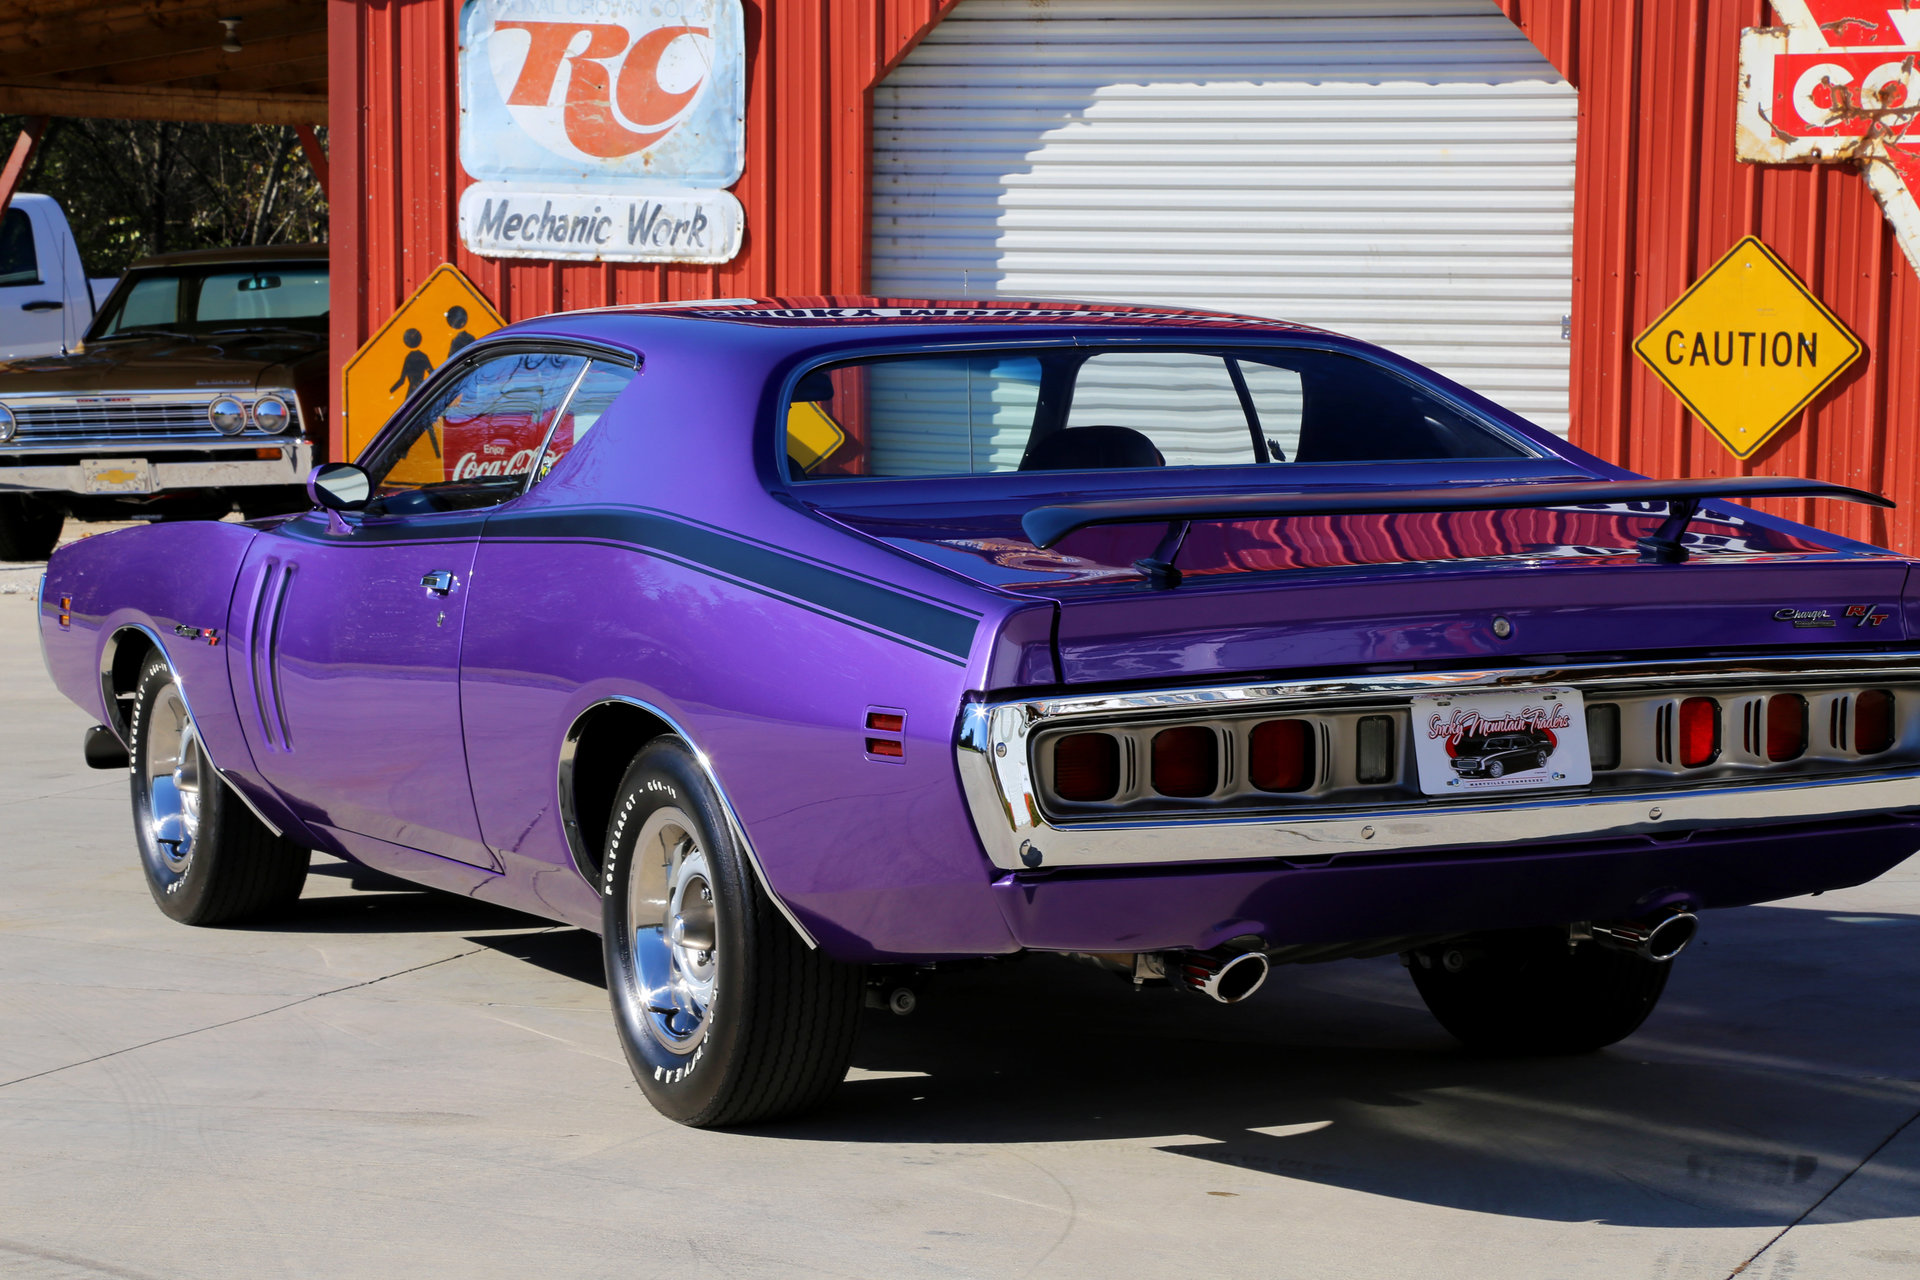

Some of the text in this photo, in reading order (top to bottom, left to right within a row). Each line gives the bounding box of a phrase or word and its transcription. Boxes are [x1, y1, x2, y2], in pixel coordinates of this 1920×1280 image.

[494, 20, 710, 158] RC
[476, 198, 708, 247] Mechanic Work
[1665, 330, 1818, 368] CAUTION
[483, 444, 506, 455] Enjoy
[1845, 604, 1889, 627] R/T
[1428, 703, 1570, 745] Smoky Mountain Traders
[605, 810, 628, 896] POLYGLAS
[625, 793, 636, 811] GT
